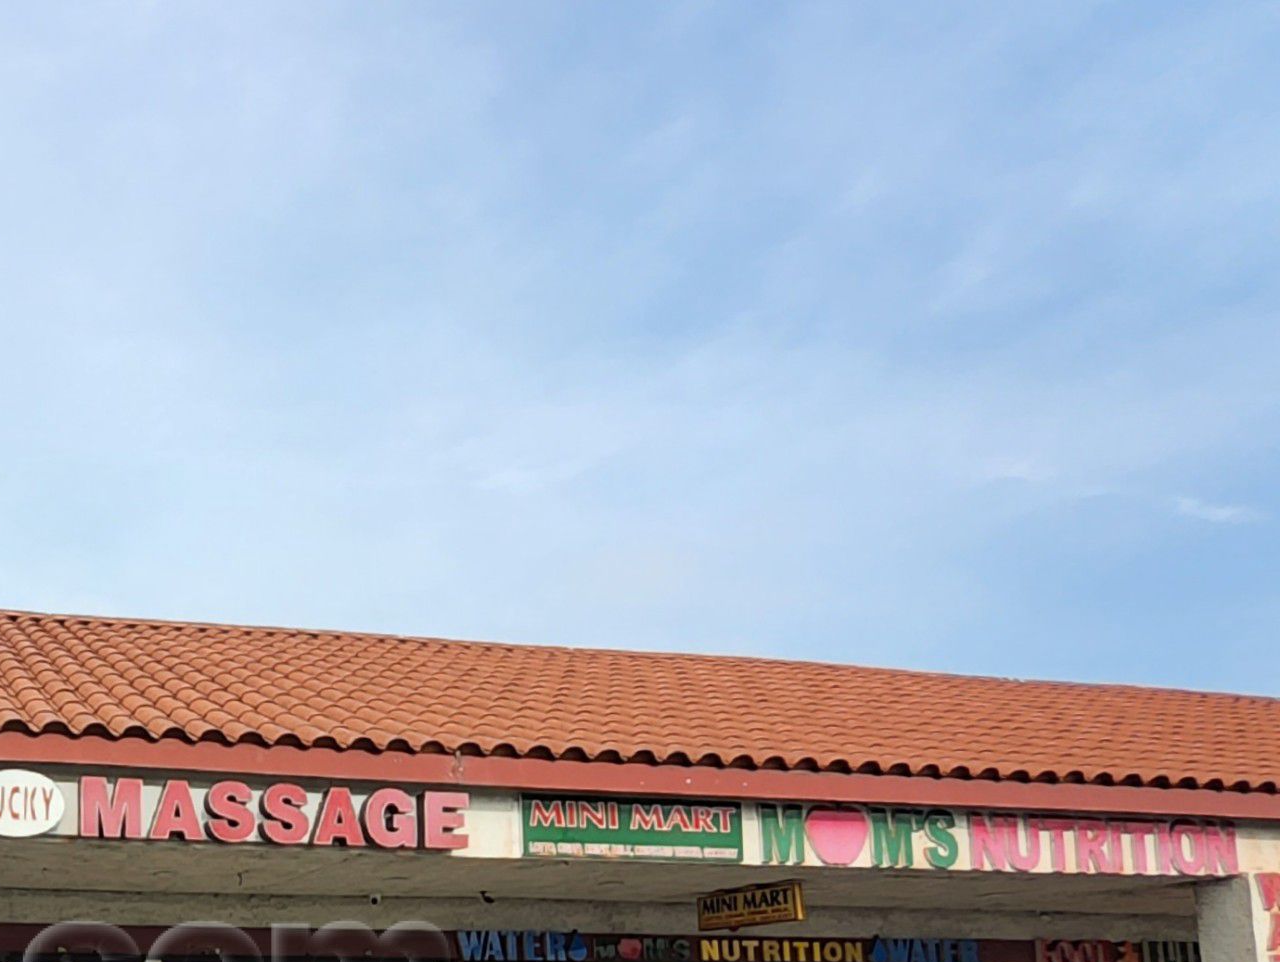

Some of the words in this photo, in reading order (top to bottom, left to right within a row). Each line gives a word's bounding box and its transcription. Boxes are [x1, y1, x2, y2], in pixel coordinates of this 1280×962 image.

[78, 775, 470, 851] MASSAGE
[529, 799, 619, 829] MINI
[629, 803, 737, 833] MART
[968, 810, 1239, 876] NUTRITION
[702, 895, 738, 914] MINI
[742, 888, 791, 910] MART
[457, 931, 565, 962] WATER
